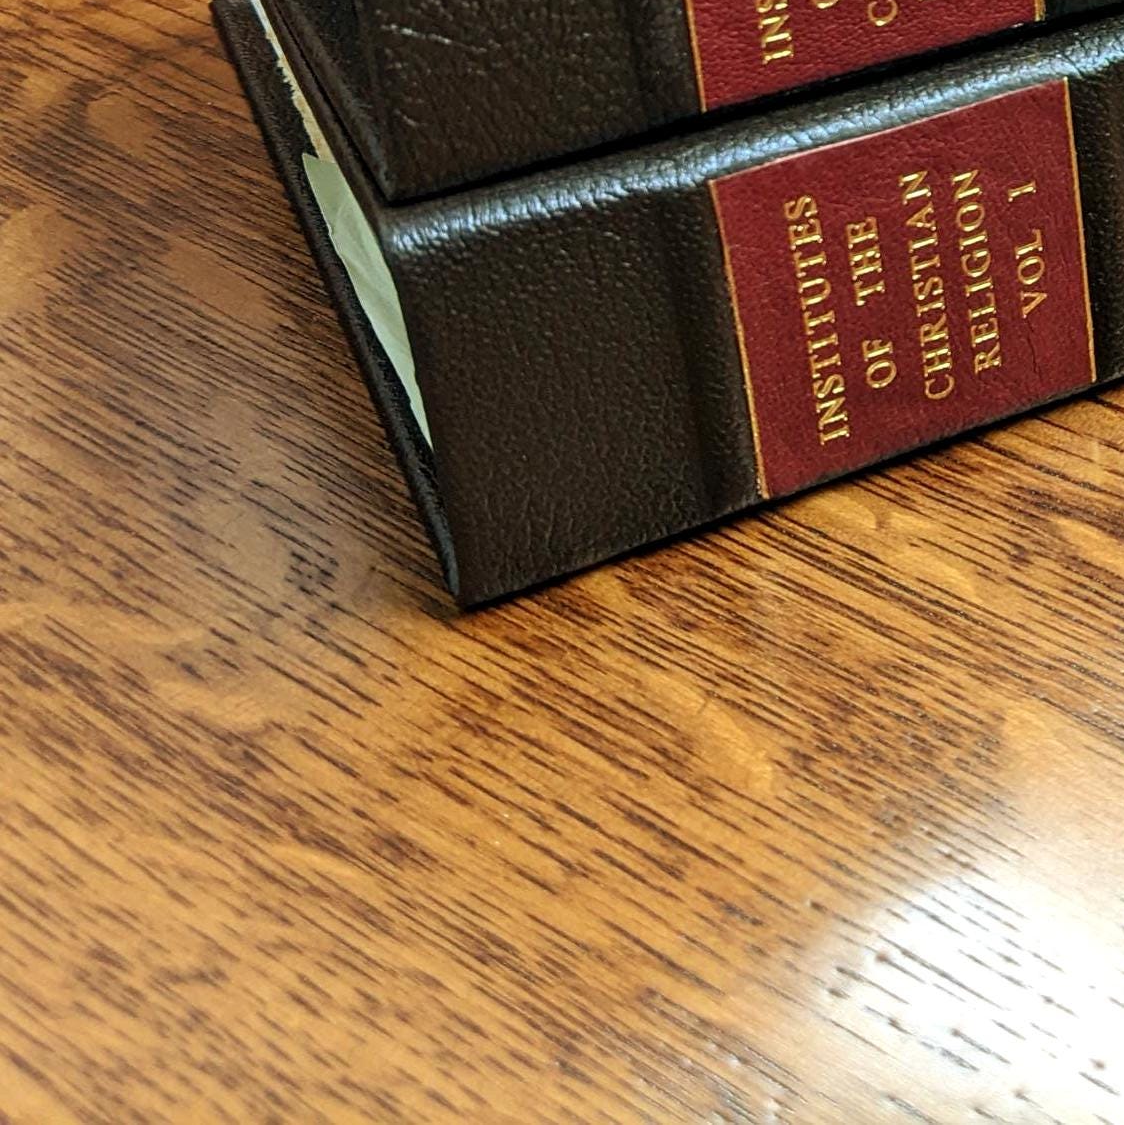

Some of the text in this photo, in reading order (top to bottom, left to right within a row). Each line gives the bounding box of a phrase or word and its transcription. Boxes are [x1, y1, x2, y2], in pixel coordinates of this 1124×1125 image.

[784, 194, 850, 445] INSTITUTES
[846, 216, 897, 389] OF THE
[900, 170, 955, 400] CHRISTIAN
[952, 169, 1002, 375] RELIGION
[1008, 180, 1047, 319] VOL I
